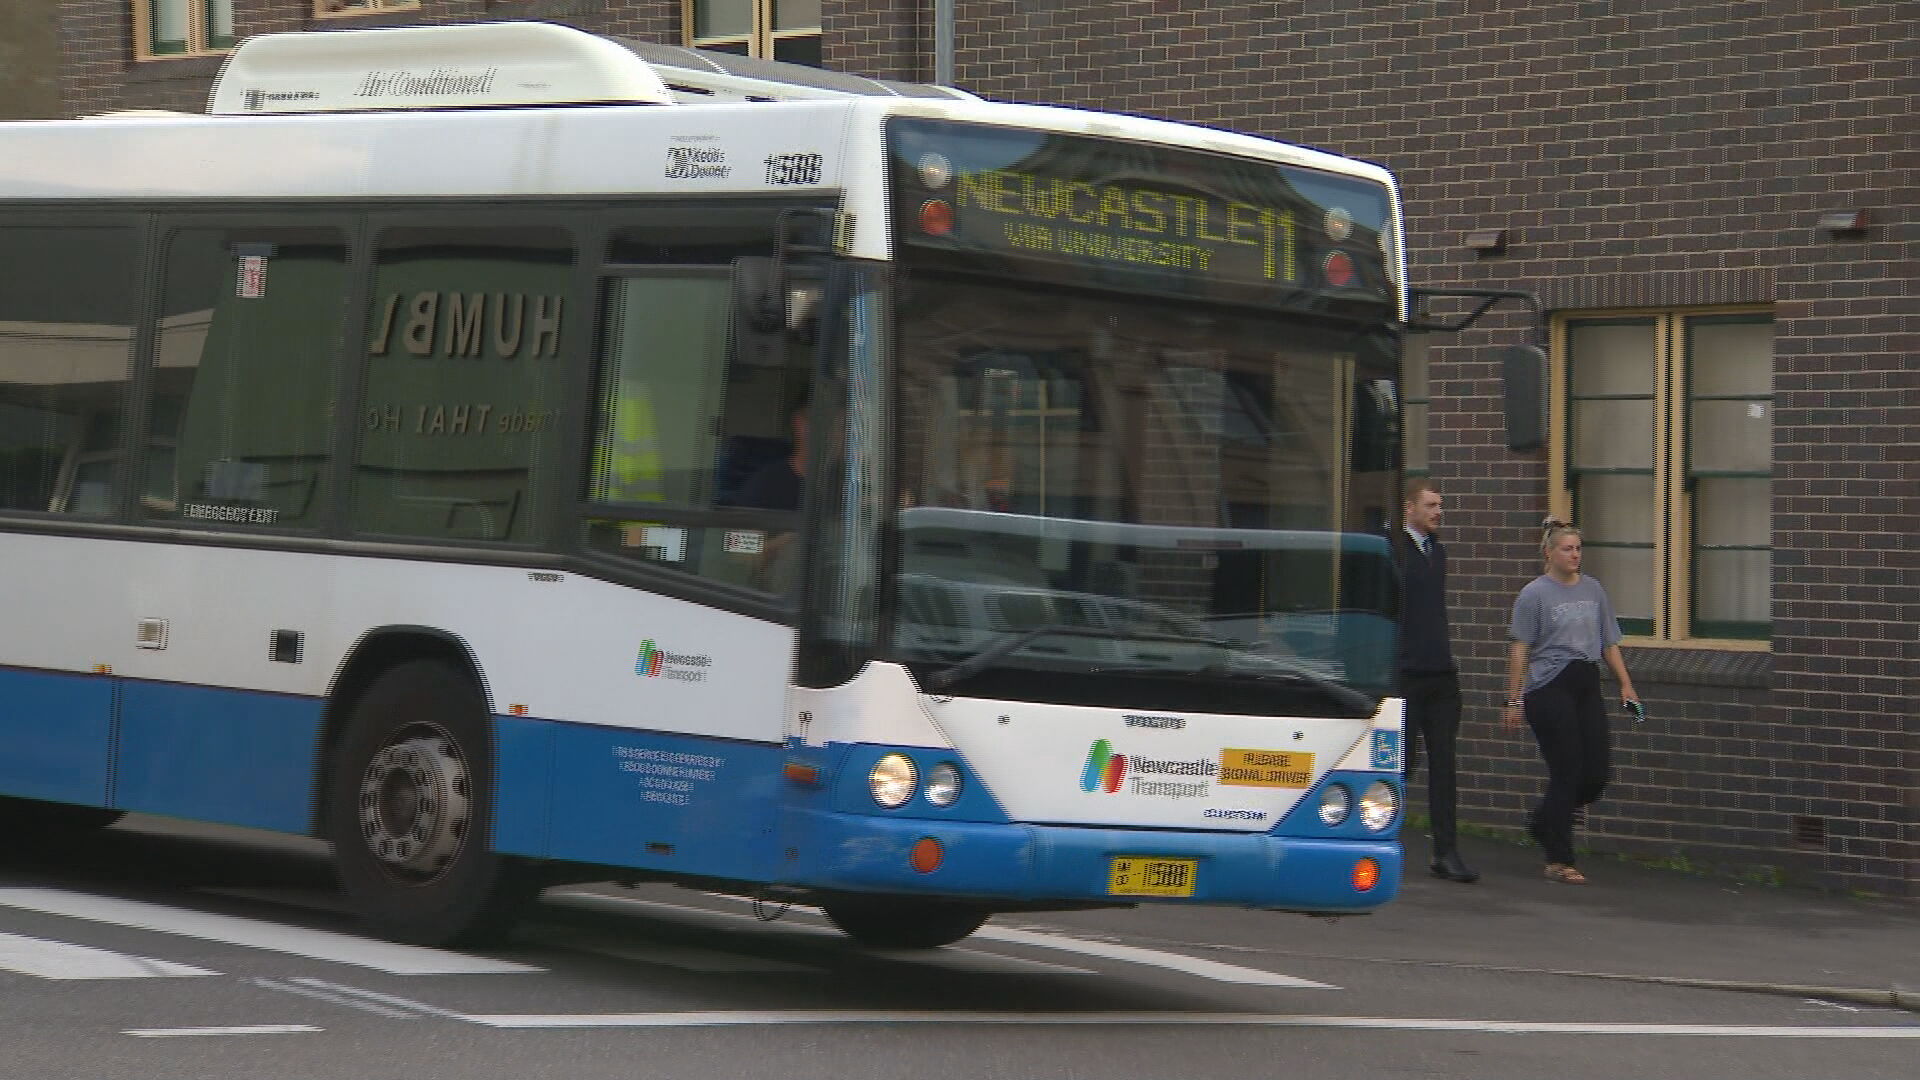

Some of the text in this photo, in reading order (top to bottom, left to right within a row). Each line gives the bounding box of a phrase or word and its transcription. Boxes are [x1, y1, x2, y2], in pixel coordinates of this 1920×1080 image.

[353, 66, 497, 97] Air Conditioned
[687, 147, 725, 163] Keolis
[685, 163, 731, 178] Downer
[763, 153, 823, 185] 1588
[957, 167, 1259, 245] NEWCASTLE
[1003, 222, 1215, 271] VIA UNIVERSITY
[1256, 207, 1295, 281] 11
[183, 503, 279, 524] EMERGENCY EXIT
[660, 650, 712, 668] Newcastle
[660, 666, 708, 684] Transport
[1122, 714, 1186, 729] VOLVO
[1129, 754, 1219, 777] Newcastle
[1243, 752, 1291, 768] PLEASE
[1218, 767, 1311, 785] SIGNAL DRIVER
[1128, 776, 1210, 801] Transport
[1203, 808, 1268, 821] CUSTOM
[1142, 863, 1189, 888] 1588
